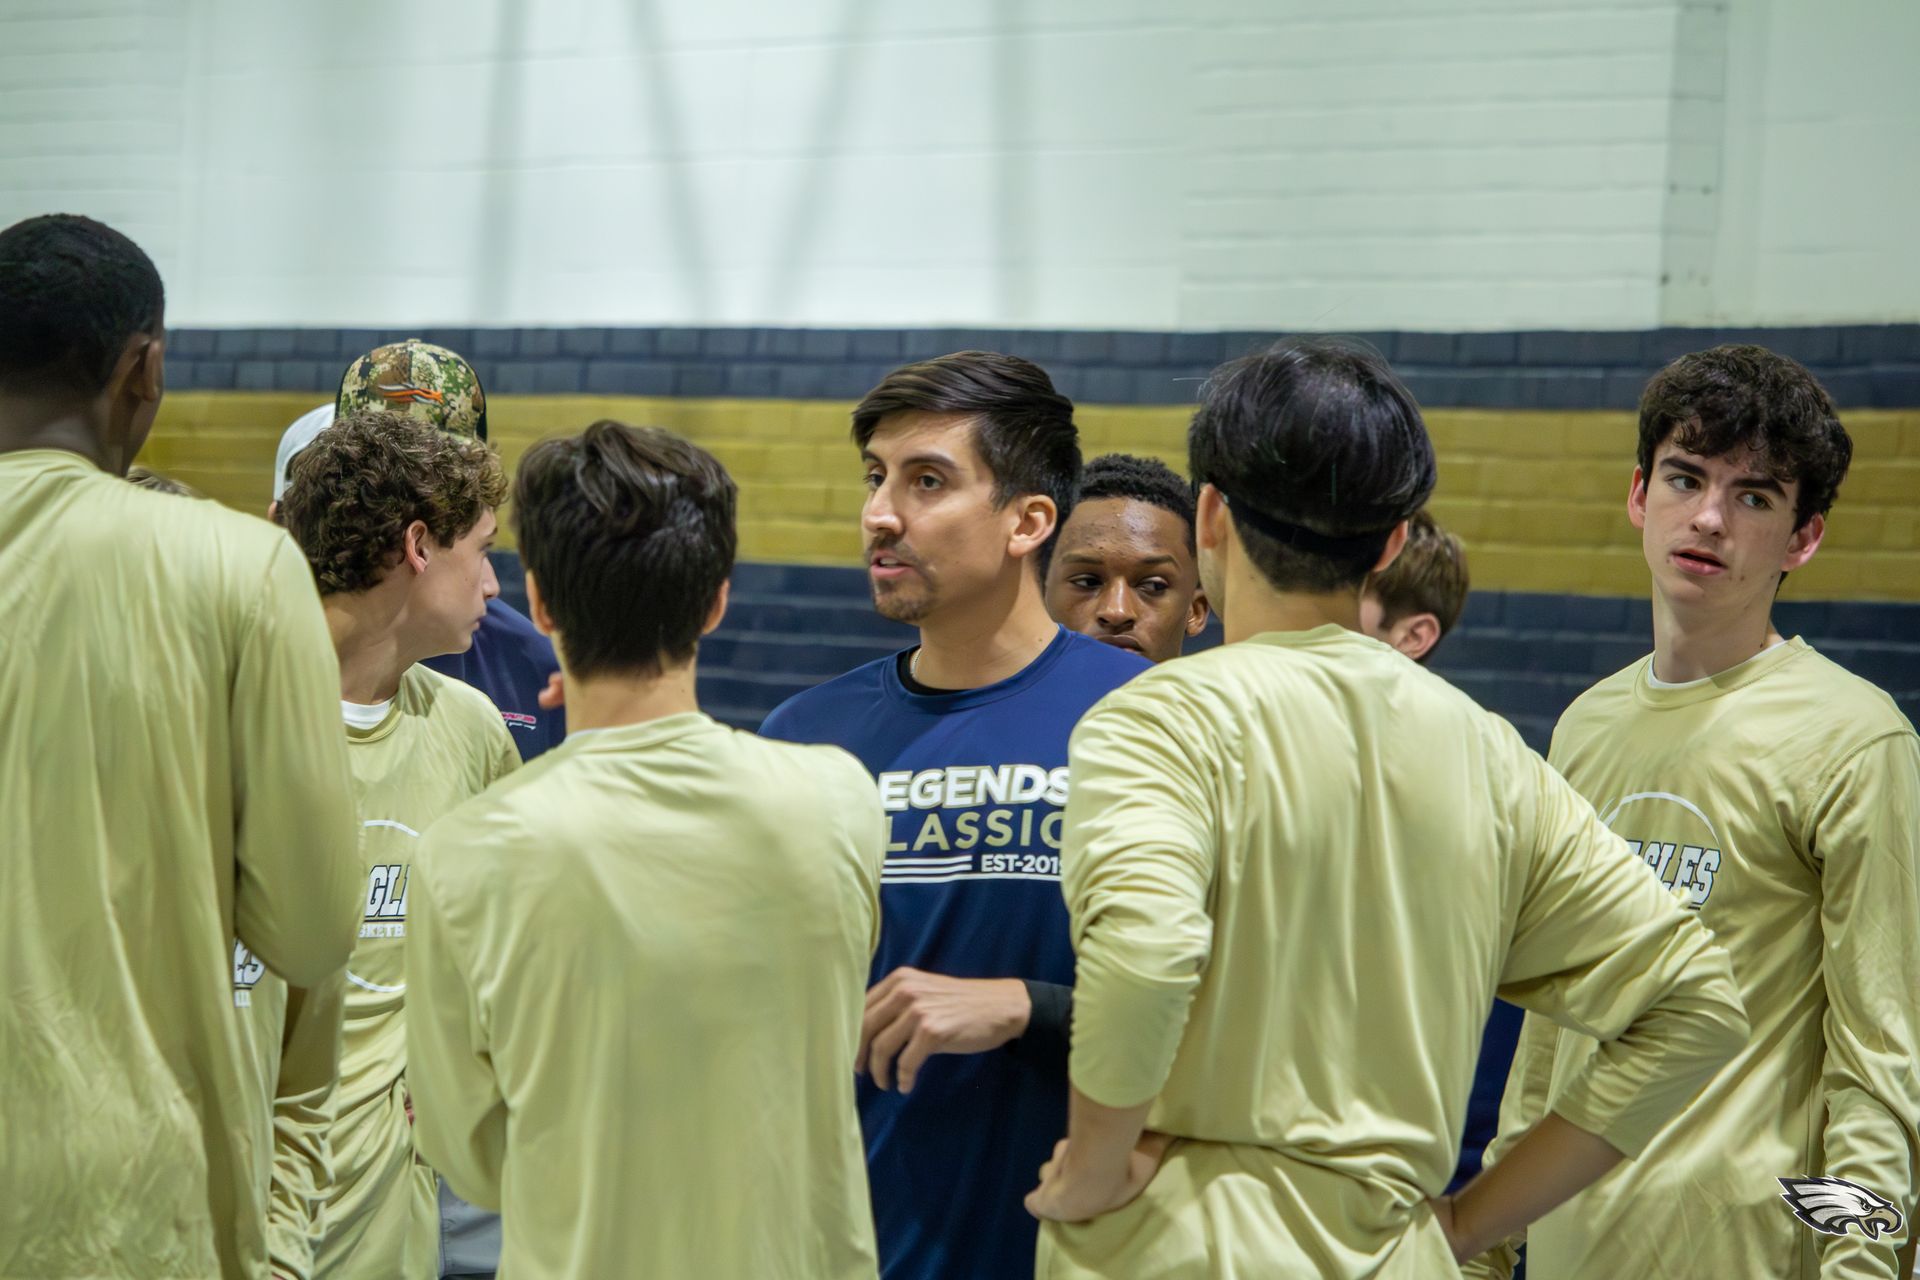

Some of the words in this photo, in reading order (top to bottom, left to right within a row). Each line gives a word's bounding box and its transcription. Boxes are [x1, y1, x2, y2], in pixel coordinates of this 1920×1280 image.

[877, 764, 1069, 811] EGENDS
[885, 809, 1064, 852] LASSIC
[981, 854, 1062, 873] EST-201
